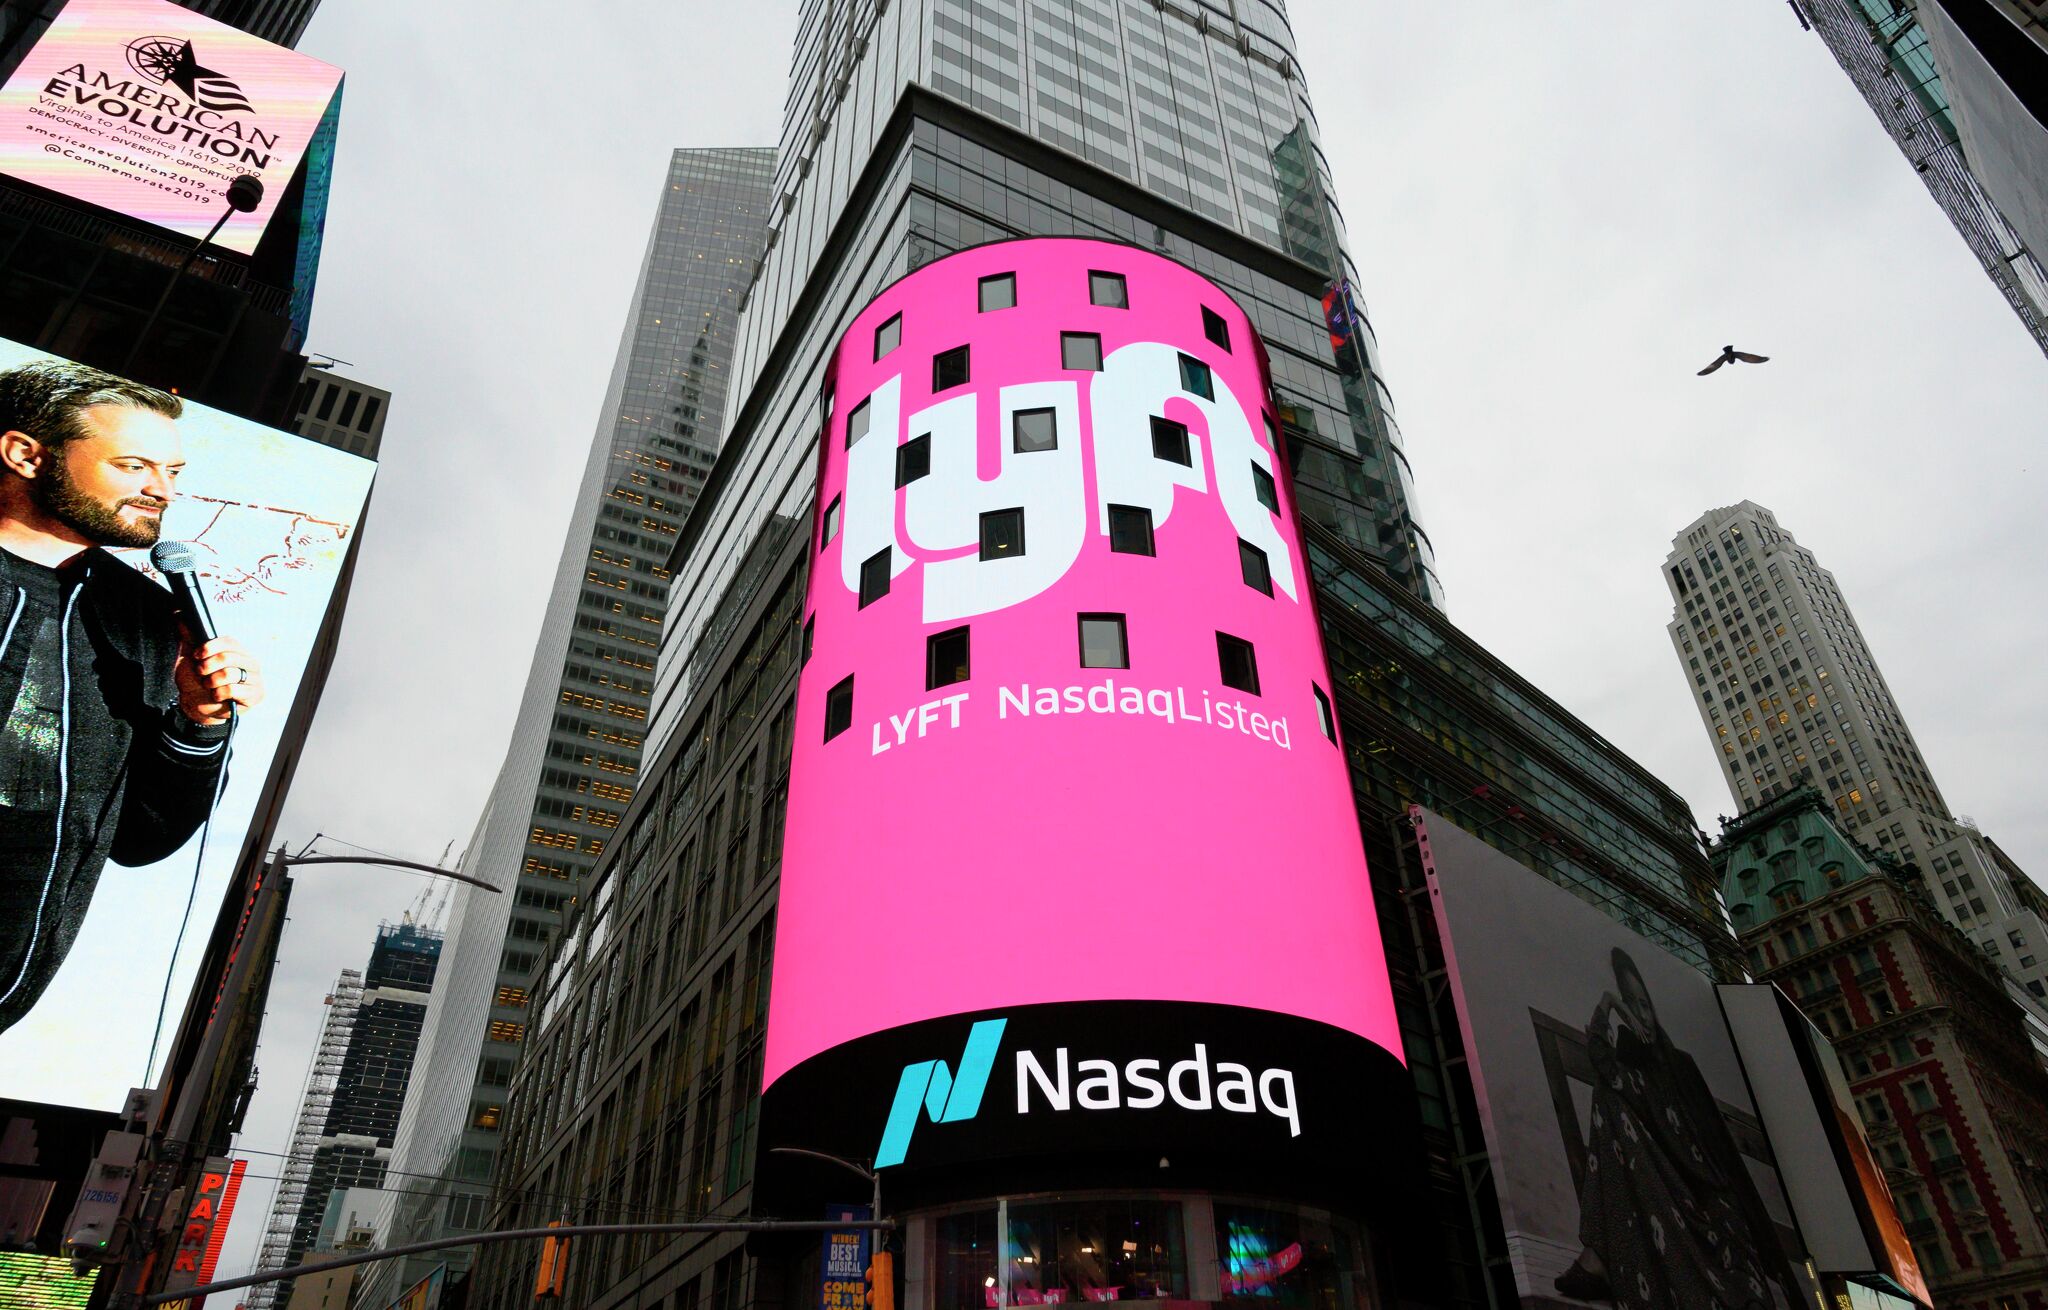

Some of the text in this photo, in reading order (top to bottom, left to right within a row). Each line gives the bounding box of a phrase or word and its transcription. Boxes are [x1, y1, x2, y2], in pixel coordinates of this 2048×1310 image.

[28, 106, 105, 137] DEMOCRACY
[110, 135, 170, 161] DIVERSITY
[39, 95, 93, 121] Virginia
[98, 118, 113, 128] to
[116, 125, 177, 151] America
[43, 77, 271, 170] EVOLUTION
[56, 63, 281, 151] AMERICAN
[26, 124, 226, 198] americanevolution2019.co
[44, 143, 211, 205] @Commemorate2019
[840, 341, 1299, 624] lyft
[871, 693, 970, 756] LYFT
[1016, 1043, 1302, 1138] Nasdaq
[174, 1172, 224, 1272] PARK
[830, 1244, 860, 1261] BEST
[823, 1281, 865, 1294] COME
[827, 1260, 862, 1273] MUSICAL
